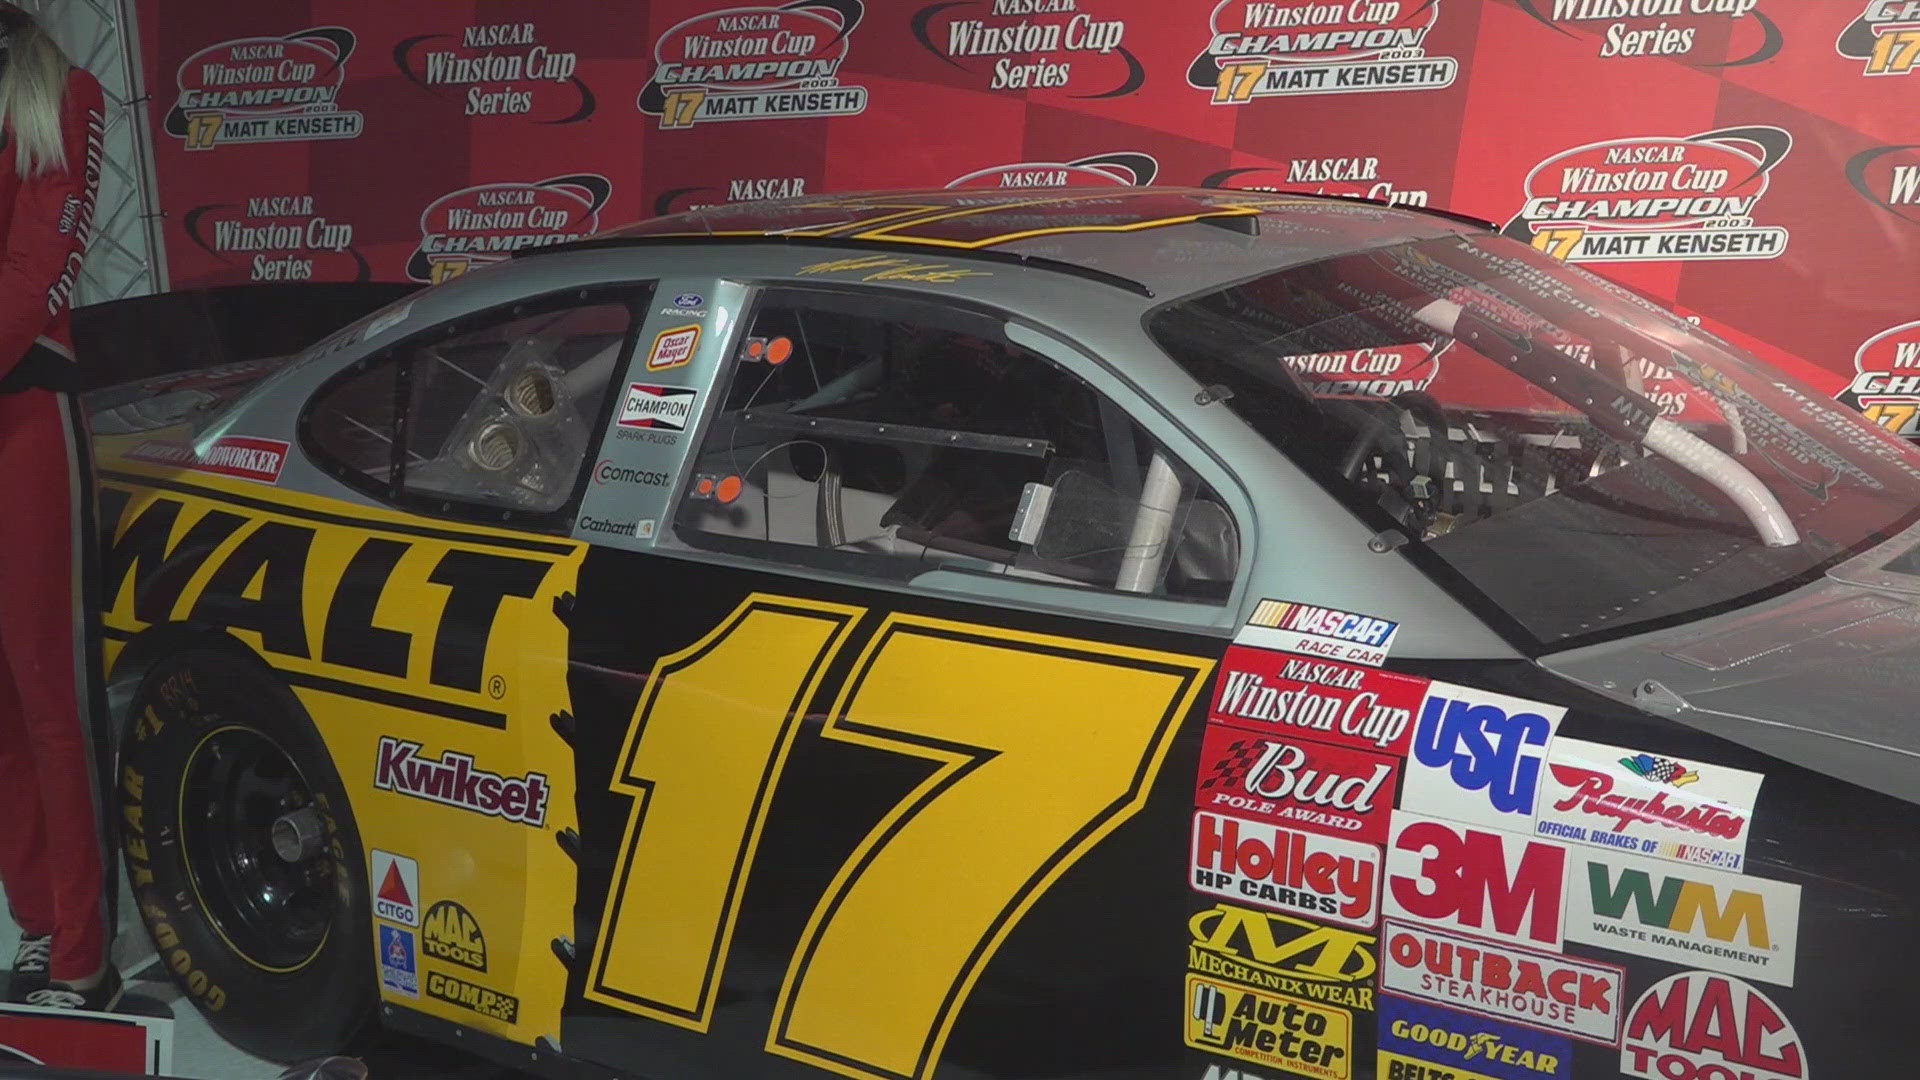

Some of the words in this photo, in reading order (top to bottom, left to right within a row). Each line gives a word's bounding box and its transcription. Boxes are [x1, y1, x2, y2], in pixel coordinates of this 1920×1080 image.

[717, 14, 780, 33] NASCAR
[1245, 2, 1341, 29] Winston
[1347, 0, 1400, 24] Cup
[462, 23, 534, 47] NASCAR
[684, 35, 766, 59] Winston
[772, 30, 816, 56] Cup
[949, 20, 1060, 56] Winston
[1065, 14, 1124, 54] Cup
[1209, 28, 1426, 55] CHAMPION
[1600, 22, 1696, 57] Series
[230, 45, 284, 61] NASCAR
[426, 50, 522, 85] Winston
[526, 46, 576, 83] Cup
[1380, 50, 1423, 60] 2003
[202, 62, 274, 86] Winston
[278, 59, 316, 83] Cup
[655, 59, 839, 84] CHAMPION
[801, 79, 837, 88] 2003
[991, 58, 1070, 90] Series
[1213, 63, 1268, 102] 17
[1266, 69, 1329, 90] MATT
[1336, 63, 1448, 87] KENSETH
[179, 86, 335, 108] CHAMPION
[465, 86, 532, 115] Series
[663, 92, 705, 127] 17
[705, 97, 758, 115] MATT
[765, 92, 859, 112] KENSETH
[186, 114, 223, 149] 17
[224, 121, 269, 138] MATT
[275, 117, 356, 136] KENSETH
[1604, 146, 1685, 164] NASCAR
[1001, 170, 1067, 186] NASCAR
[1287, 158, 1378, 182] NASCAR
[1561, 167, 1668, 193] Winston
[1672, 164, 1728, 193] Cup
[477, 191, 535, 206] NASCAR
[728, 178, 804, 201] NASCAR
[247, 196, 313, 217] NASCAR
[447, 207, 524, 231] Winston
[528, 206, 568, 231] Cup
[1522, 197, 1755, 220] CHAMPION
[215, 220, 302, 250] Winston
[306, 217, 352, 252] Cup
[1706, 219, 1751, 228] 2003
[1583, 237, 1650, 256] MATT
[1657, 233, 1778, 254] KENSETH
[251, 254, 312, 281] Series
[661, 308, 708, 318] RACING
[657, 346, 689, 361] Mayer
[663, 335, 689, 349] Oscar
[1351, 348, 1401, 376] Cup
[626, 397, 688, 417] CHAMPION
[616, 429, 644, 441] SPARK
[648, 433, 677, 446] PLUGS
[580, 516, 636, 536] Carhartt
[1287, 604, 1391, 646] NASCAR
[1295, 638, 1341, 658] RACE
[1346, 647, 1385, 665] CAR
[1279, 658, 1364, 690] NASCAR
[1216, 669, 1341, 731] Winston
[1341, 691, 1411, 748] Cup
[1413, 695, 1550, 815] USG
[376, 738, 548, 824] Kwikset
[1244, 741, 1393, 814] Bud
[1212, 793, 1275, 814] POLE
[1277, 806, 1362, 832] AWARD
[1549, 763, 1745, 839] Raybestos
[584, 592, 1217, 1080] 17
[1537, 820, 1586, 841] OFFICIAL
[1590, 829, 1639, 850] BRAKES
[1642, 839, 1658, 853] OF
[1682, 845, 1741, 869] NASCAR
[1197, 814, 1374, 919] Holley
[1196, 869, 1232, 889] HP
[1239, 879, 1337, 914] CARBS
[1390, 822, 1565, 944] 3M
[377, 901, 414, 923] CITGO
[1587, 861, 1770, 950] WM
[424, 906, 483, 953] MAC
[1593, 922, 1646, 941] WASTE
[1651, 934, 1769, 966] MANAGEMENT
[425, 939, 483, 967] TOOLS
[1187, 945, 1305, 993] MECHANIX
[1304, 982, 1374, 1011] WEAR
[1390, 932, 1611, 1015] OUTBACK
[429, 974, 497, 1008] COMP
[1421, 973, 1576, 1024] STEAKHOUSE
[1234, 995, 1327, 1035] Auto
[1628, 976, 1801, 1077] MAC
[1224, 1021, 1344, 1067] Meter
[1234, 1048, 1283, 1065] COMPETITION
[1286, 1060, 1338, 1078] INSTRUMENTS
